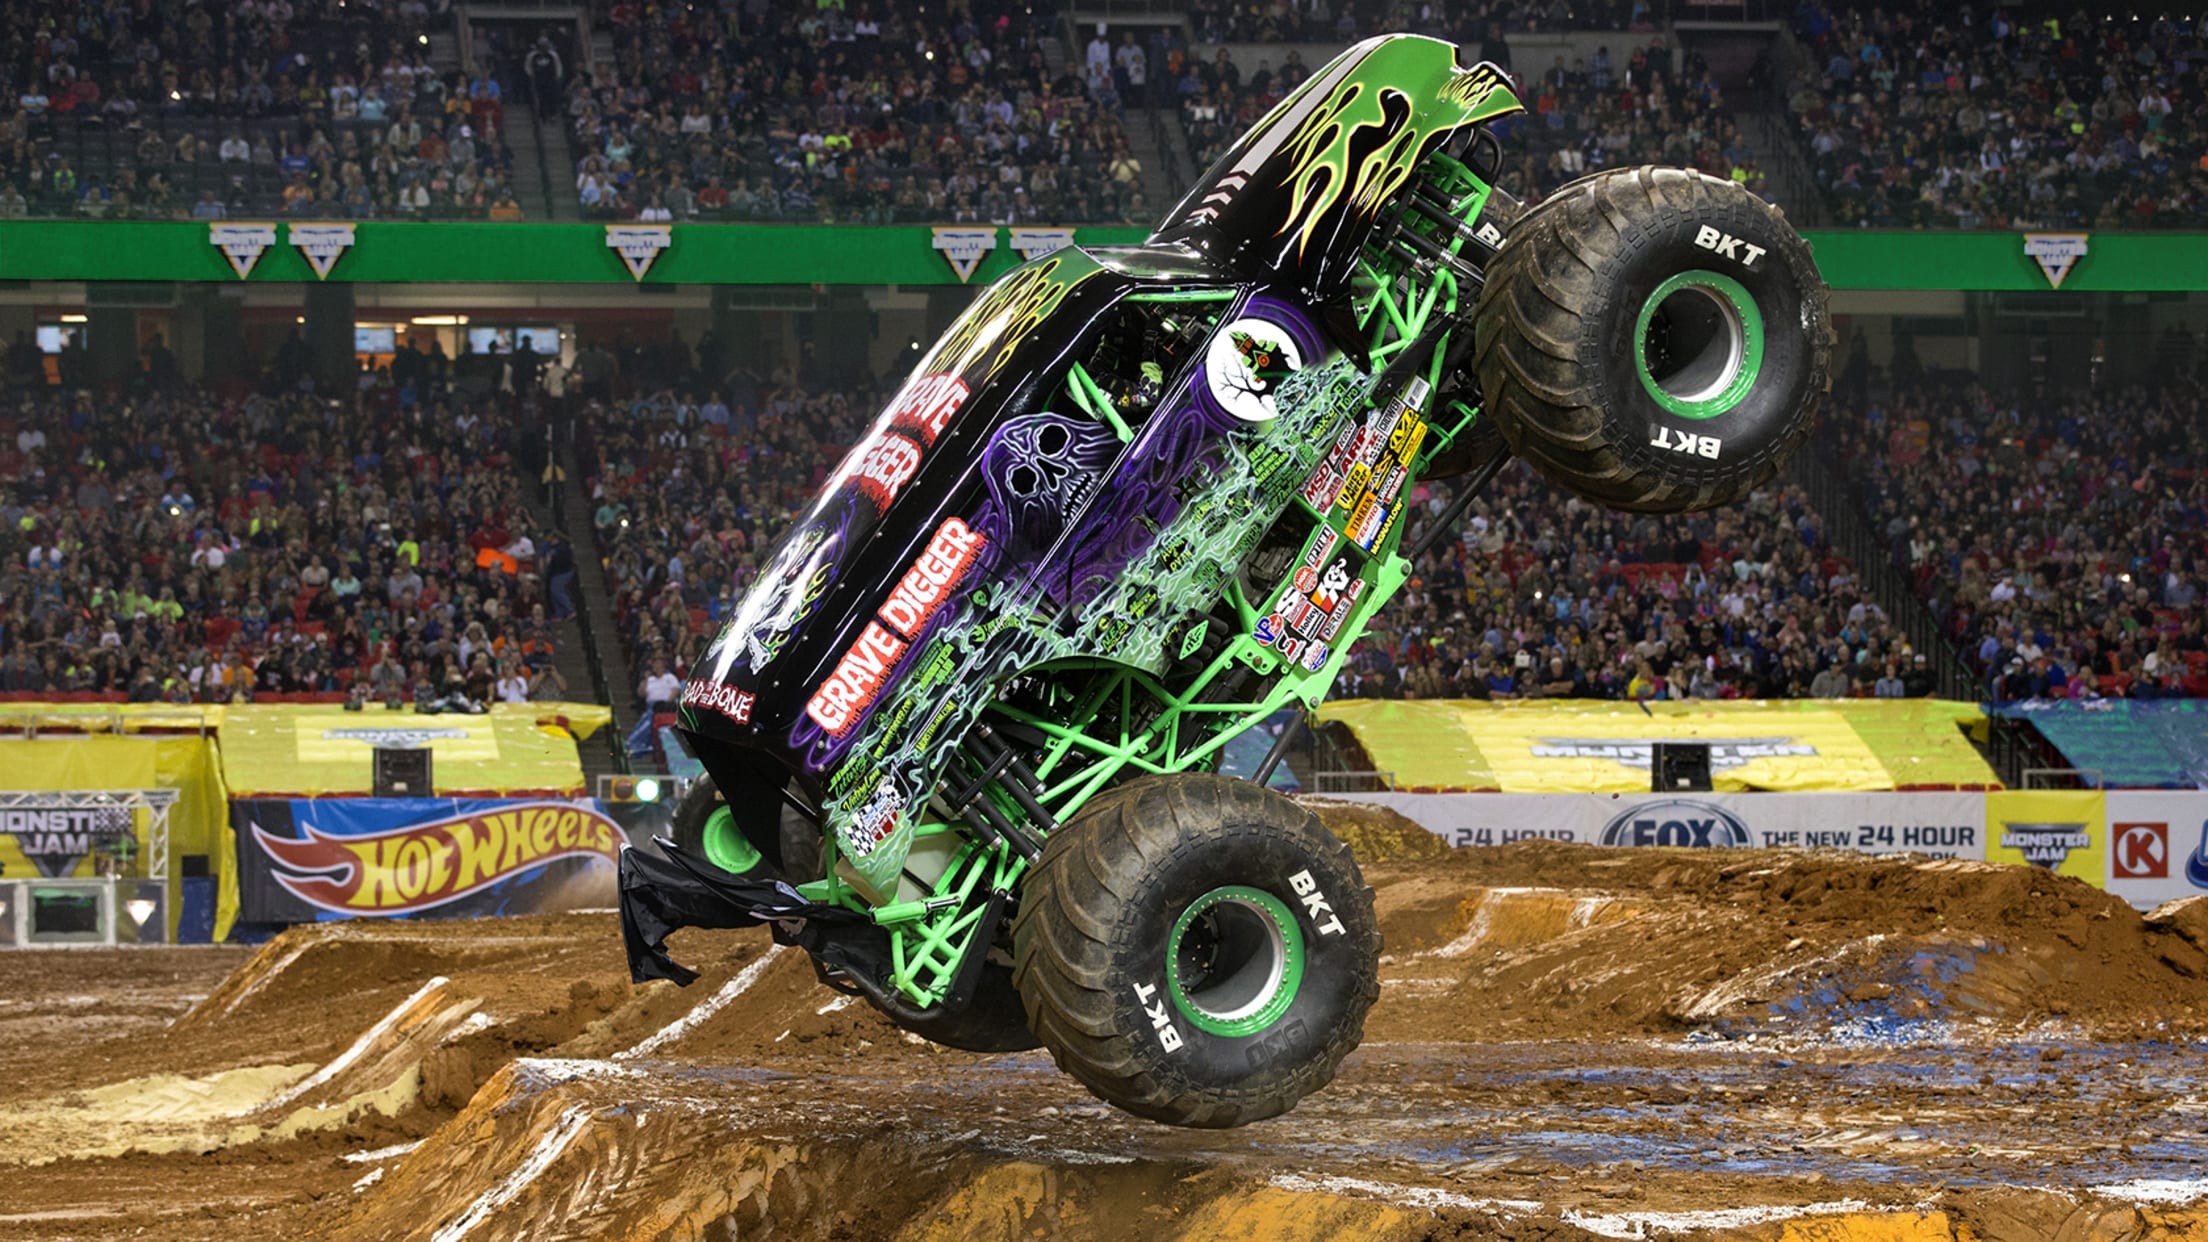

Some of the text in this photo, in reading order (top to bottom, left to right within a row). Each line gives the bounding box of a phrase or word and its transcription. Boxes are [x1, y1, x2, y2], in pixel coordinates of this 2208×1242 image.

[1694, 225, 1766, 266] BKT
[893, 374, 969, 432] RAVE
[1336, 386, 1359, 410] Toro
[1379, 399, 1400, 431] CROWER
[1340, 425, 1368, 474] ARP
[1651, 426, 1721, 460] BKT
[1305, 462, 1329, 502] MSD
[1376, 468, 1398, 502] LINCOLN
[1350, 496, 1372, 531] TIMKEN
[1371, 501, 1403, 553] MAGNAFLOW
[1307, 527, 1331, 563] OPTIMA
[1317, 558, 1350, 603] K&N
[808, 517, 977, 731] GRAVE DIGGER
[1252, 616, 1273, 642] VP
[1298, 608, 1318, 633] Holley
[707, 683, 752, 721] BONE
[0, 810, 96, 832] ONST
[1456, 828, 1493, 848] 24
[1634, 819, 1717, 848] FOX
[1762, 826, 1974, 847] THE NEW 24 HOUR
[24, 833, 88, 854] JAM
[2000, 834, 2090, 848] MONSTER
[2025, 848, 2066, 862] JAM
[341, 835, 454, 906] HOT
[1287, 869, 1346, 938] BKT
[1133, 982, 1184, 1053] BKT
